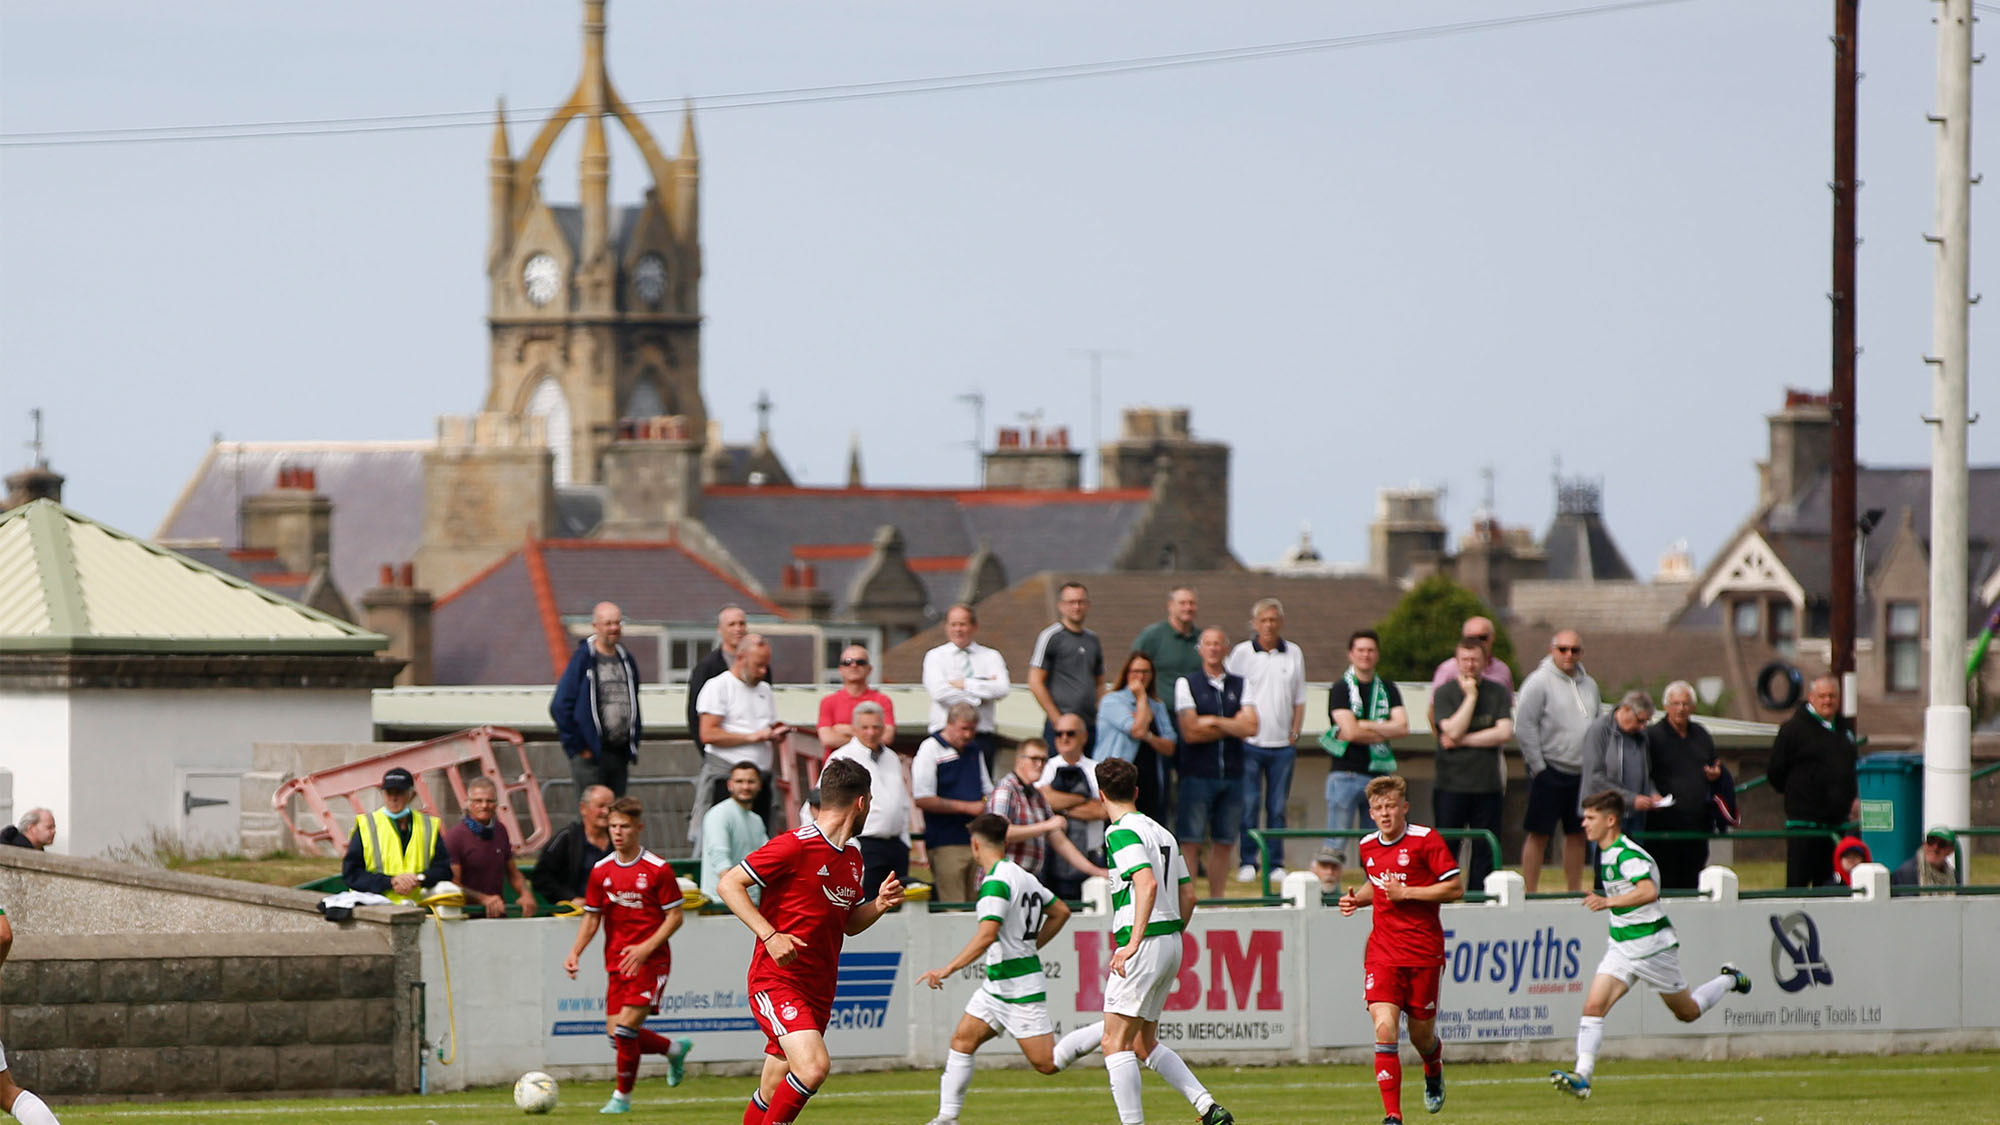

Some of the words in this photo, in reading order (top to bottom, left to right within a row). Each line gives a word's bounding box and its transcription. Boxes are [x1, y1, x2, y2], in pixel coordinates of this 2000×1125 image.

[1159, 844, 1171, 893] 7
[1021, 891, 1043, 940] 22
[829, 1003, 885, 1029] ector
[1724, 1009, 1777, 1025] Premium
[1780, 1006, 1821, 1026] Drilling
[1826, 1005, 1858, 1023] Tools
[1861, 1006, 1882, 1023] Ltd
[1188, 1022, 1270, 1040] MERCHANTS
